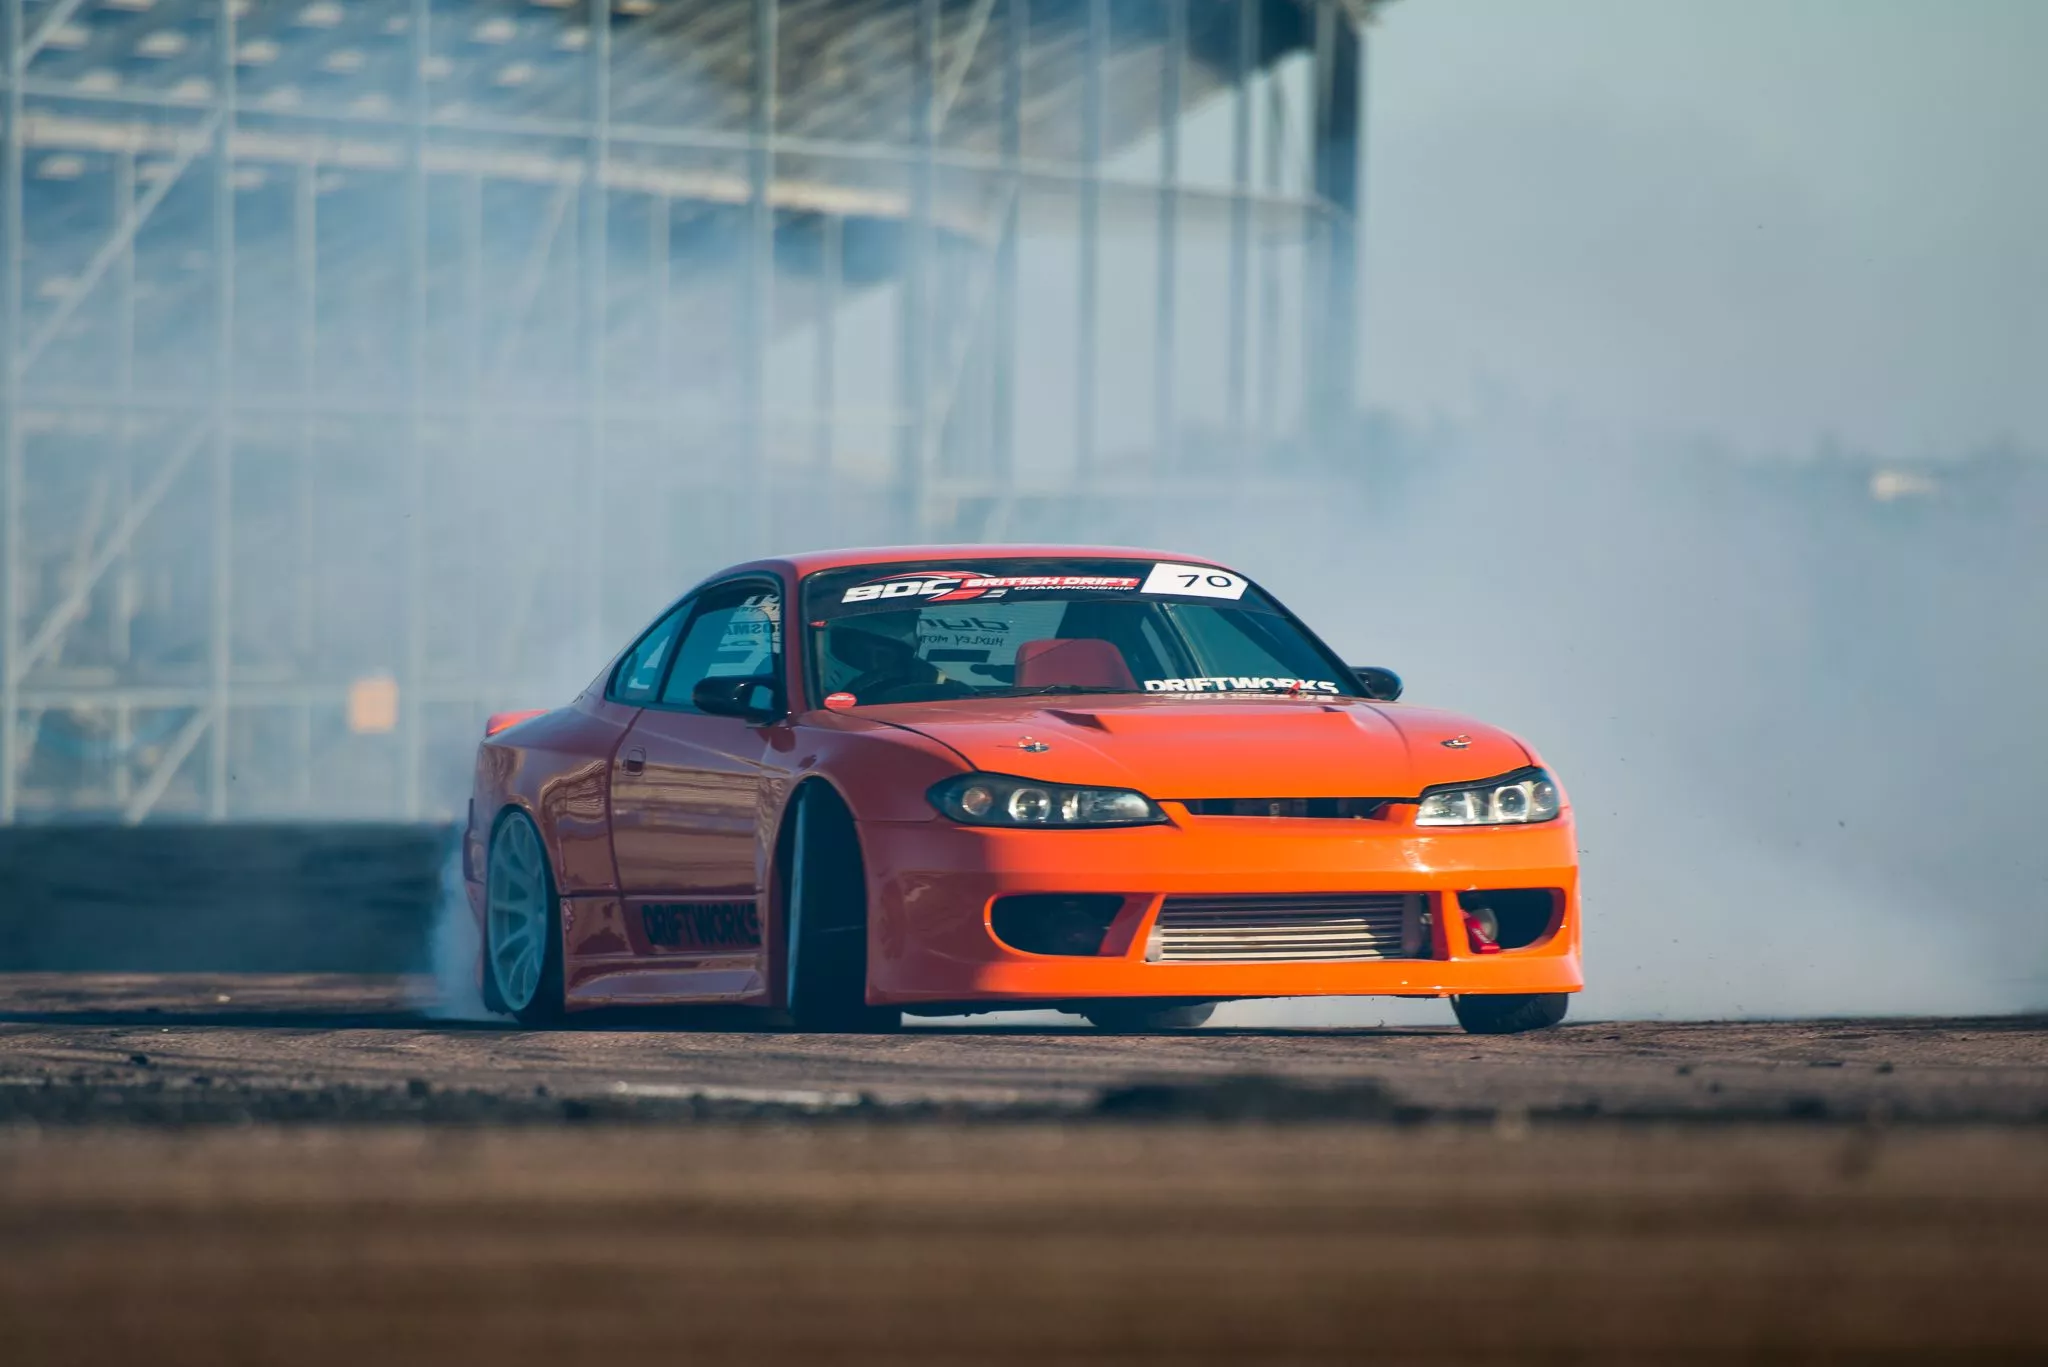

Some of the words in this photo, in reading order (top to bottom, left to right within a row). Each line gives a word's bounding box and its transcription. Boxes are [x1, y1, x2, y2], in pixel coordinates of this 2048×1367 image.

[966, 577, 1057, 588] BRITISH
[1063, 577, 1134, 587] DRIFT
[1177, 574, 1232, 588] 70
[841, 578, 962, 603] BDC
[1143, 676, 1340, 694] DRIFTWORKS
